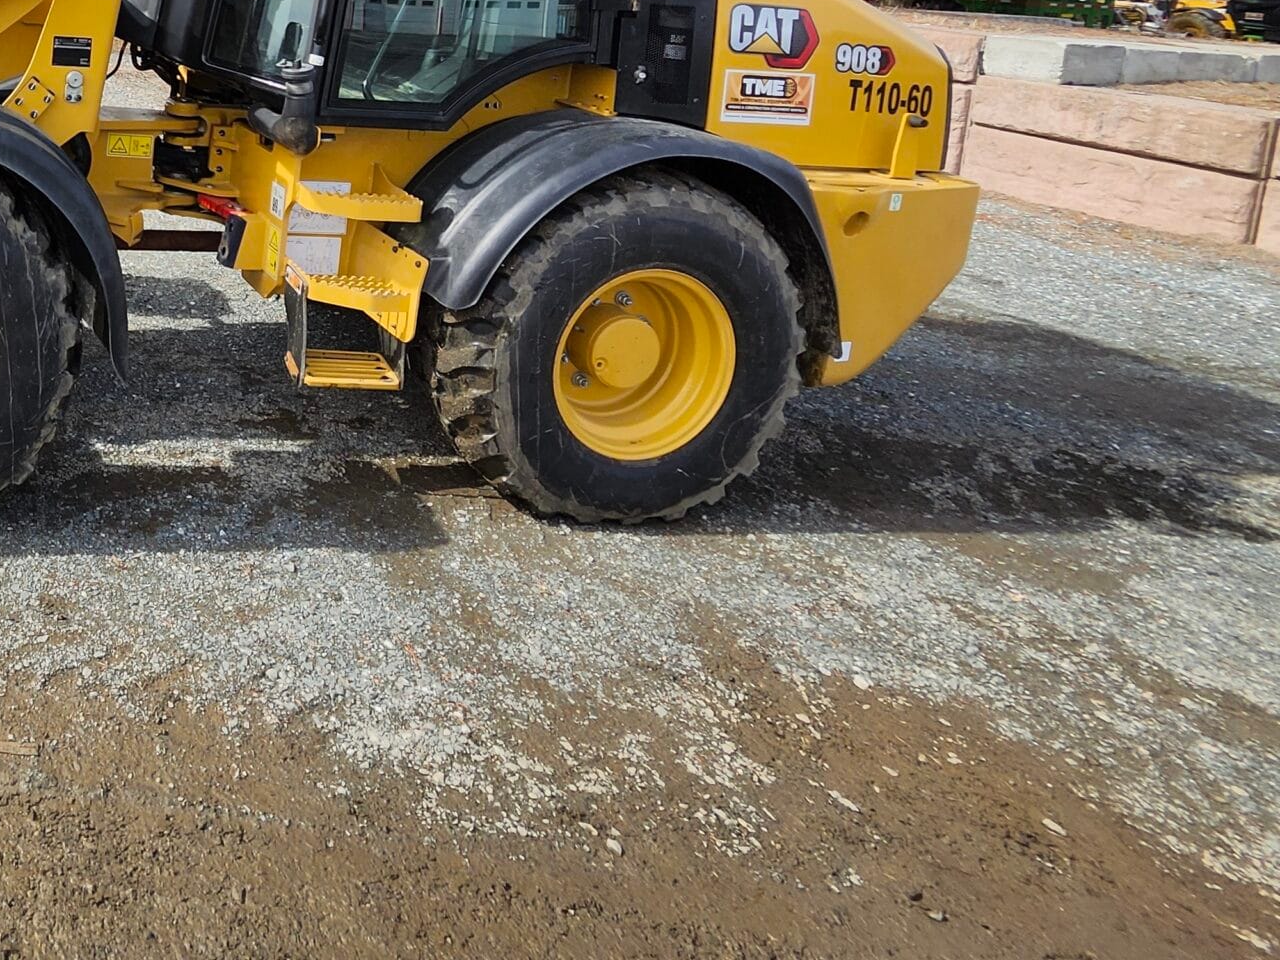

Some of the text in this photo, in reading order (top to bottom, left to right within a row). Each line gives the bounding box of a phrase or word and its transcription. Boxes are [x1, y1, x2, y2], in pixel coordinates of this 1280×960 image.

[730, 4, 800, 55] CAT
[836, 44, 882, 74] 908
[742, 77, 786, 97] TME
[849, 79, 933, 117] T110-60
